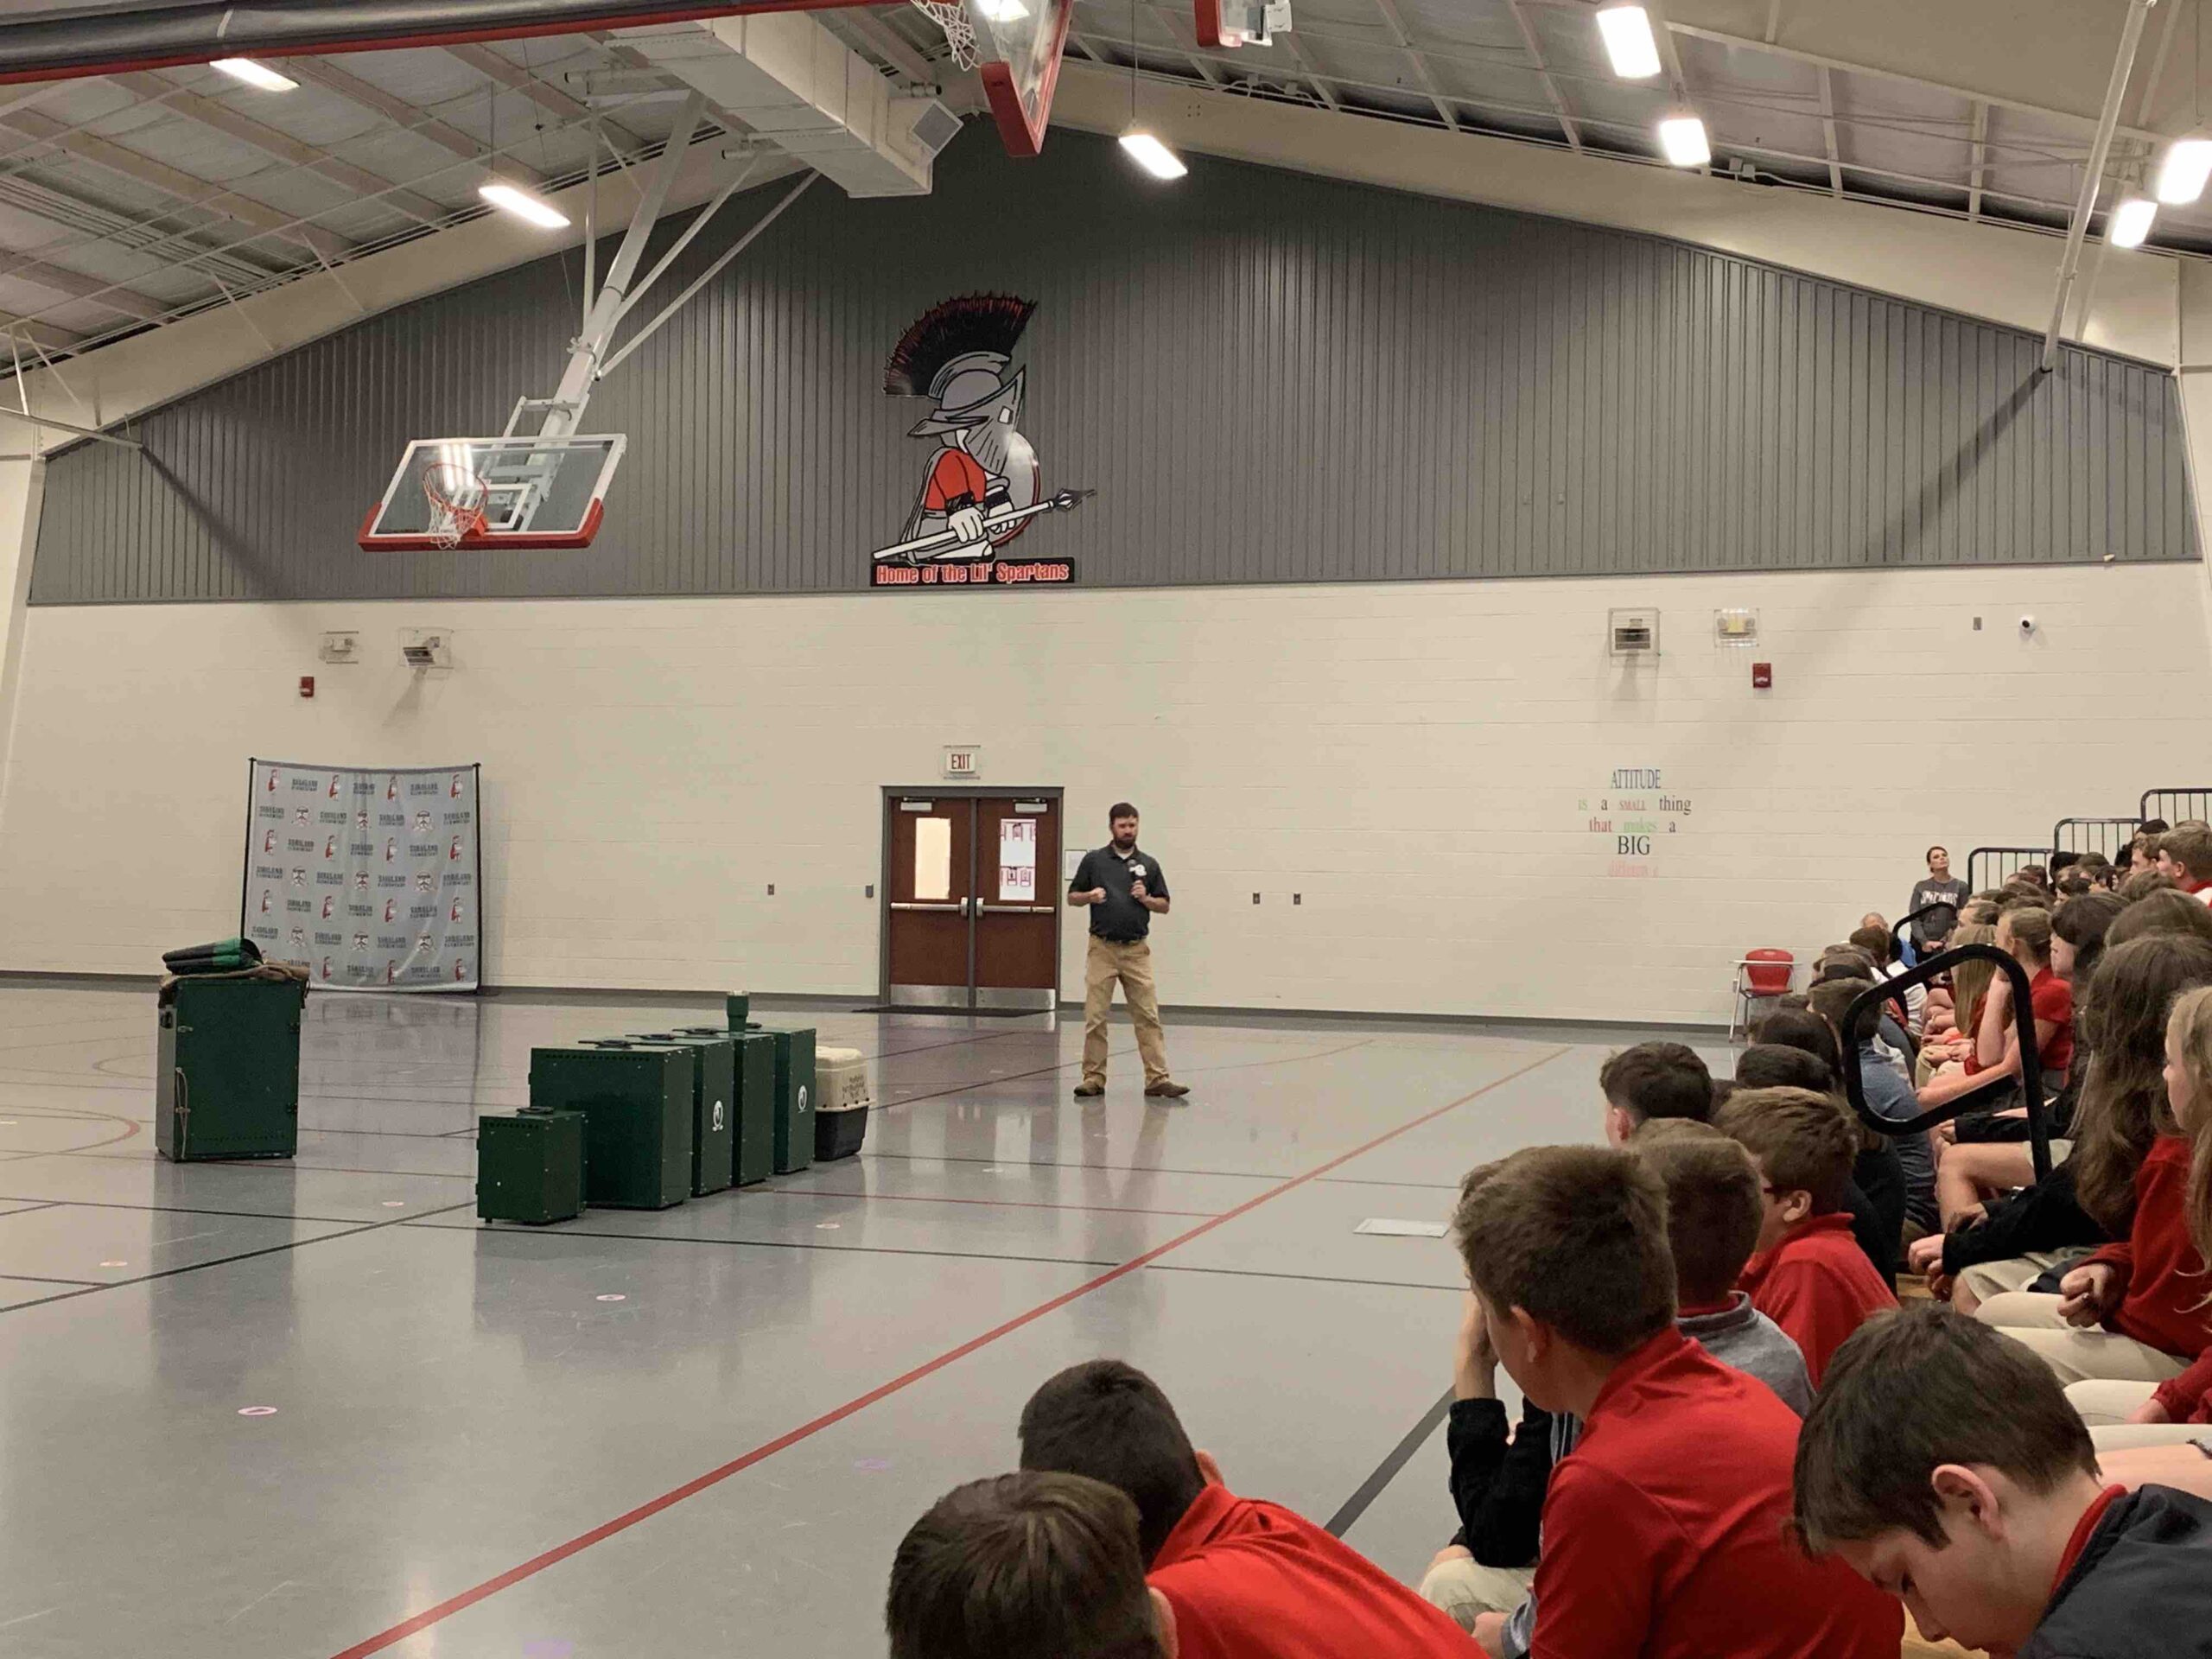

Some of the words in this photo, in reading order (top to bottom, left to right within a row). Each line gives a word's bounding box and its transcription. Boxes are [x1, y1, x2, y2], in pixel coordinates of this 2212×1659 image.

[876, 565, 918, 584] Home
[922, 565, 938, 583] of
[942, 564, 966, 582] the
[996, 562, 1069, 584] Spartans
[951, 753, 971, 770] EXIT
[1611, 769, 1662, 790] ATTITUDE
[1601, 798, 1608, 811] a
[1659, 795, 1692, 816] thing
[1589, 817, 1612, 833] that
[1669, 821, 1676, 833] a
[1618, 835, 1650, 855] BIG
